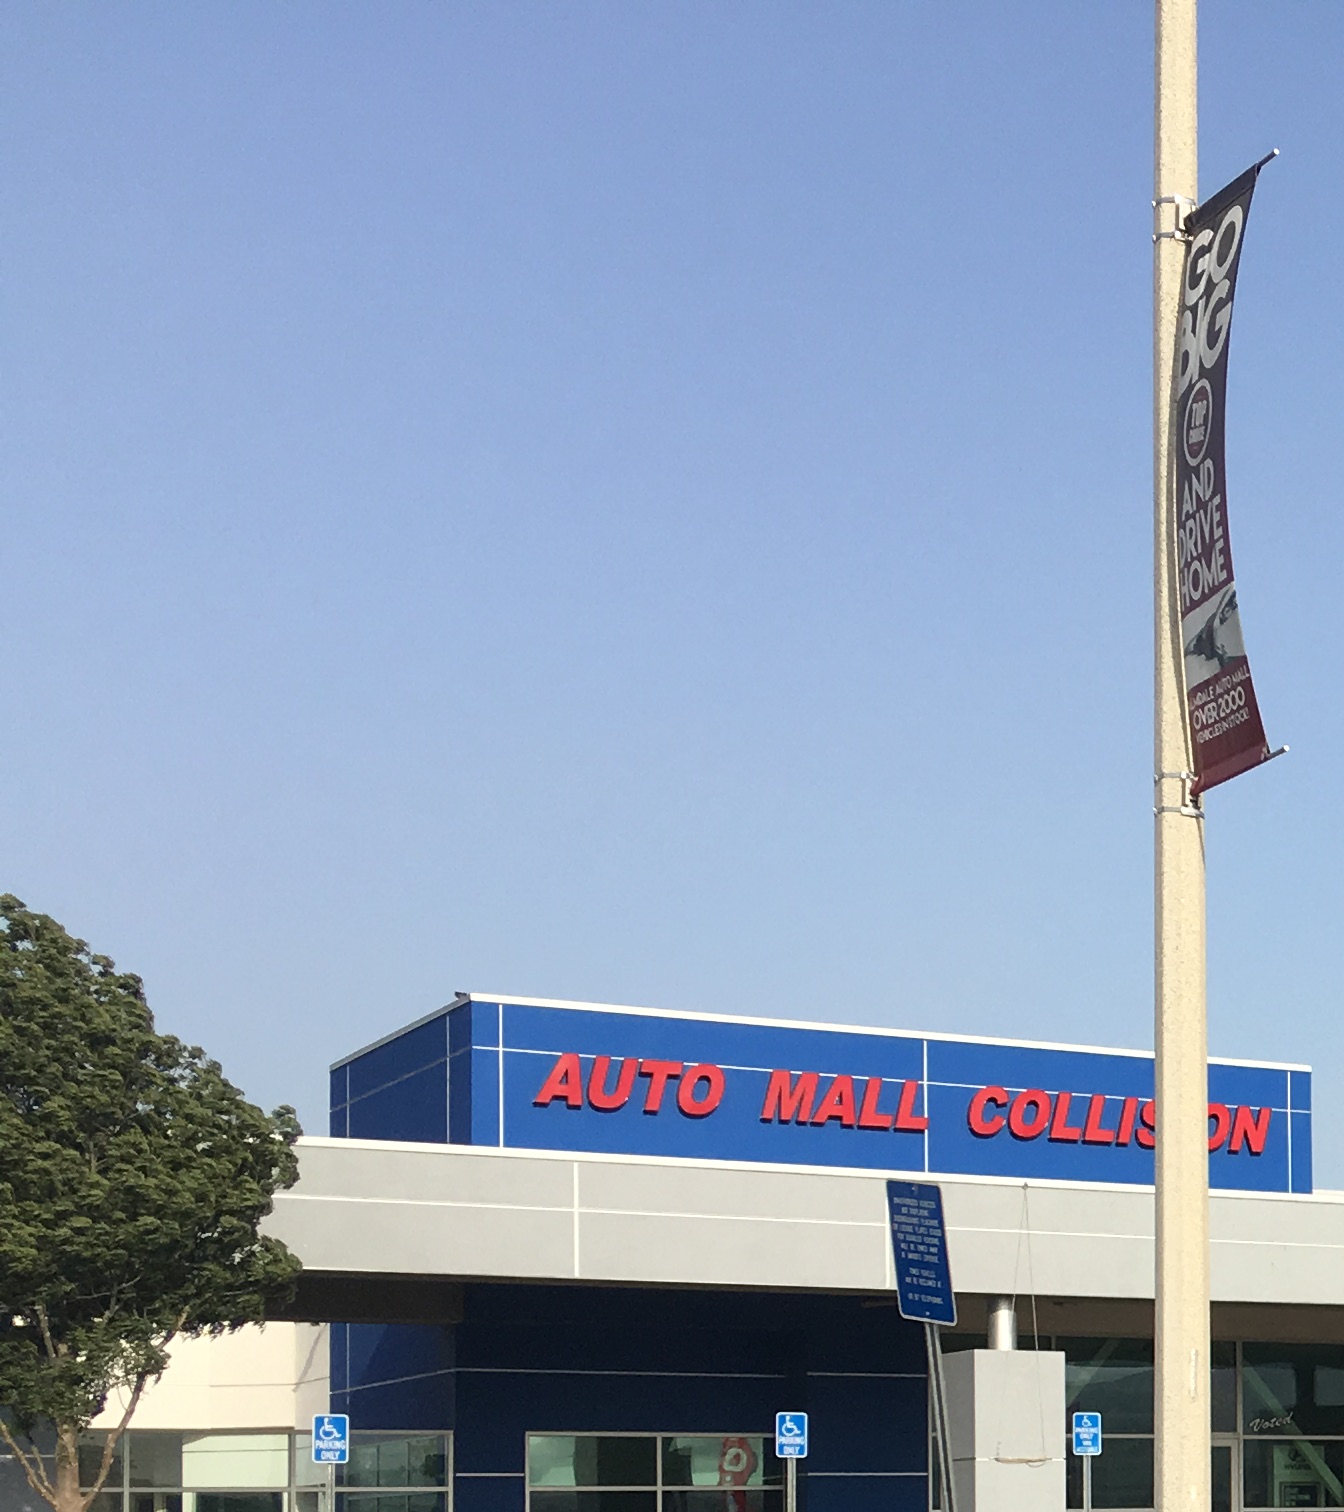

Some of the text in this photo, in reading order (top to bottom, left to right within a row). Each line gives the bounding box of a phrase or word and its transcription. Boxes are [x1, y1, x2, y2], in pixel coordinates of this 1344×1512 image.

[1185, 205, 1243, 307] GO
[1177, 278, 1232, 401] BIG
[1182, 458, 1214, 521] AND
[1178, 494, 1224, 568] DRIVE
[1180, 538, 1228, 611] HOME
[1193, 686, 1246, 730] OVER 2000
[532, 1053, 1272, 1157] AUTO MALL COLLISON
[315, 1440, 346, 1450] PARKING
[320, 1450, 340, 1460] ONLY
